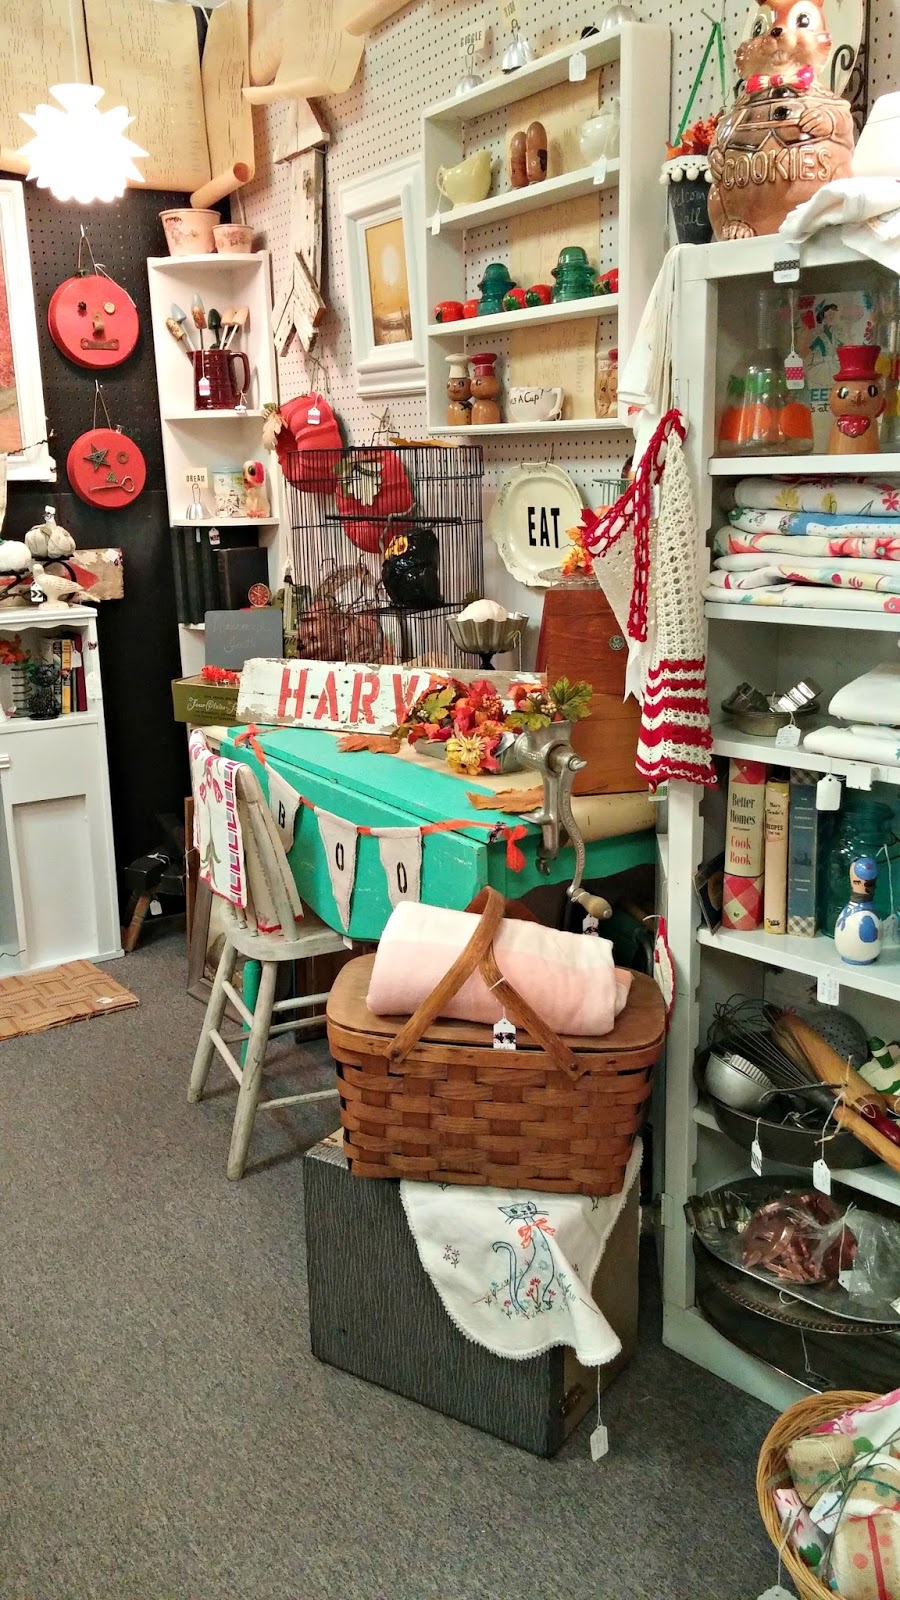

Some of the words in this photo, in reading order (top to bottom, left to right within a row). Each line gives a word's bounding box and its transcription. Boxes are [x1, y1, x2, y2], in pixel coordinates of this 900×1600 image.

[723, 147, 832, 190] COOKIES
[186, 475, 205, 483] DREAM
[527, 506, 560, 549] EAT
[277, 668, 420, 726] HARV
[732, 793, 756, 809] Better
[730, 809, 756, 826] Homes
[730, 835, 752, 850] Cook
[730, 851, 752, 866] Book
